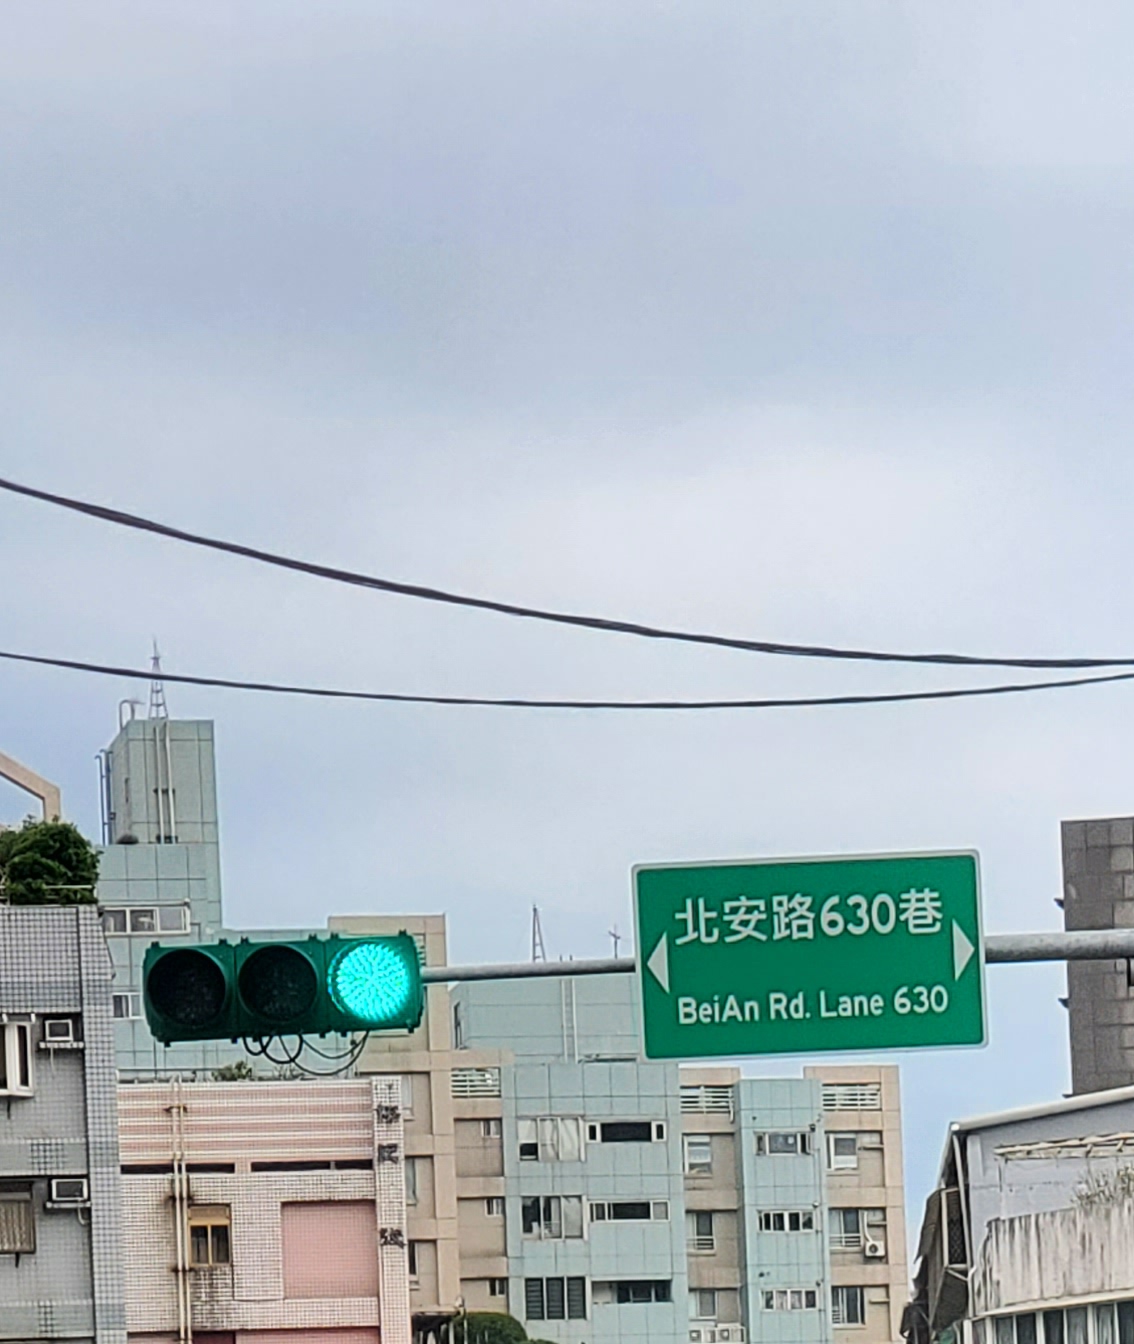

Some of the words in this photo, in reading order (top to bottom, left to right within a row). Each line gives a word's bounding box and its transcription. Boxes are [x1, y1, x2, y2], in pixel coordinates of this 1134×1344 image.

[674, 888, 943, 945] 北安路630巷
[678, 994, 760, 1025] BeiAn
[769, 991, 811, 1021] Rd.
[820, 990, 884, 1018] Lane
[893, 985, 949, 1014] 630
